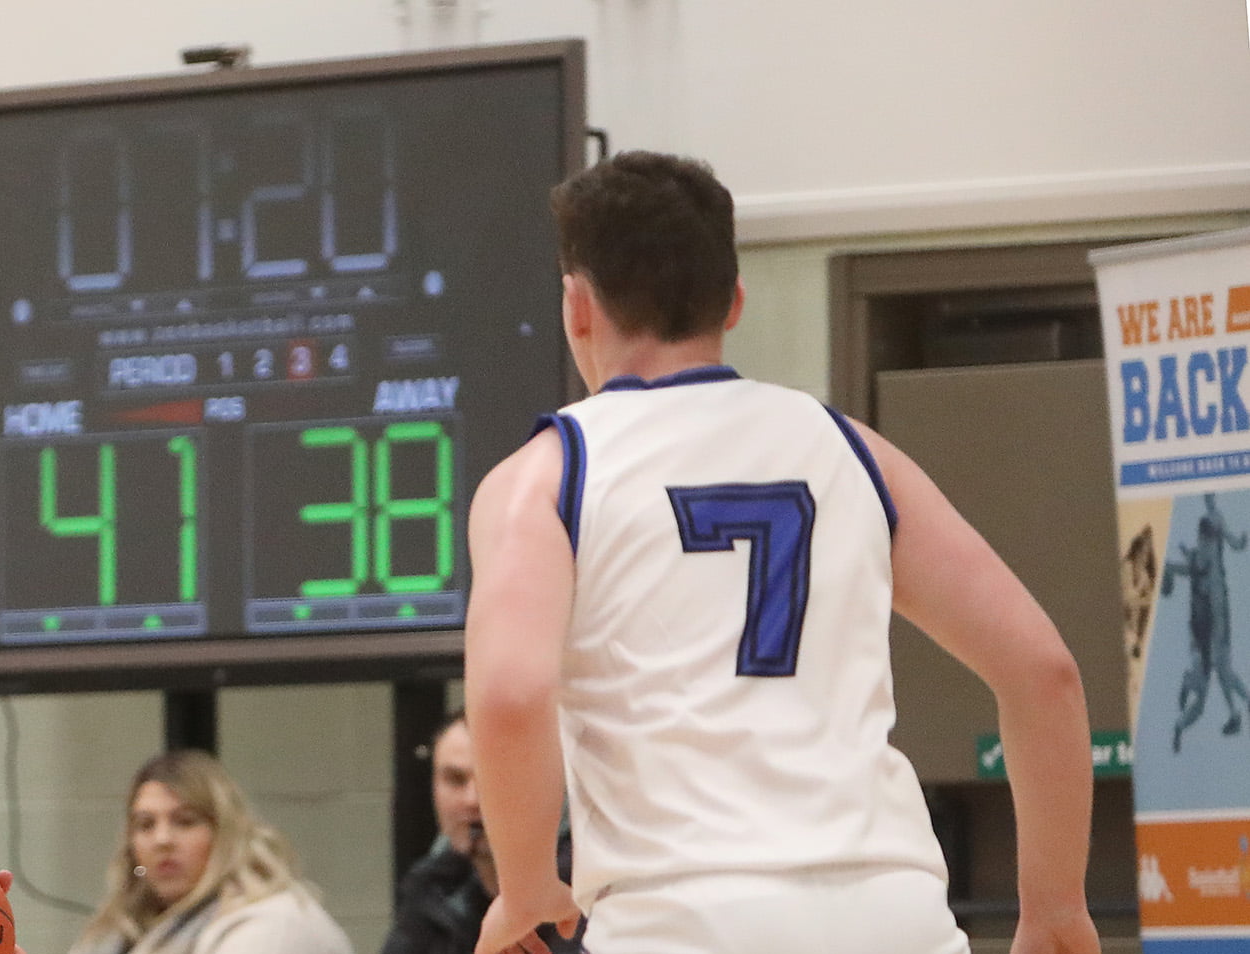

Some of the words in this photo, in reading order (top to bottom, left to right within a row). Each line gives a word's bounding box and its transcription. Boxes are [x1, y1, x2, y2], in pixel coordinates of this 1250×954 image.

[1117, 301, 1161, 346] WE
[1167, 293, 1215, 340] ARE
[217, 351, 235, 378] 1
[253, 348, 274, 379] 2
[291, 345, 312, 376] 3
[328, 343, 350, 370] 4
[372, 376, 460, 413] AWAY
[1120, 346, 1250, 443] BACK
[3, 400, 83, 436] HOME
[40, 435, 198, 606] 41
[298, 422, 454, 597] 38
[665, 480, 816, 677] 7
